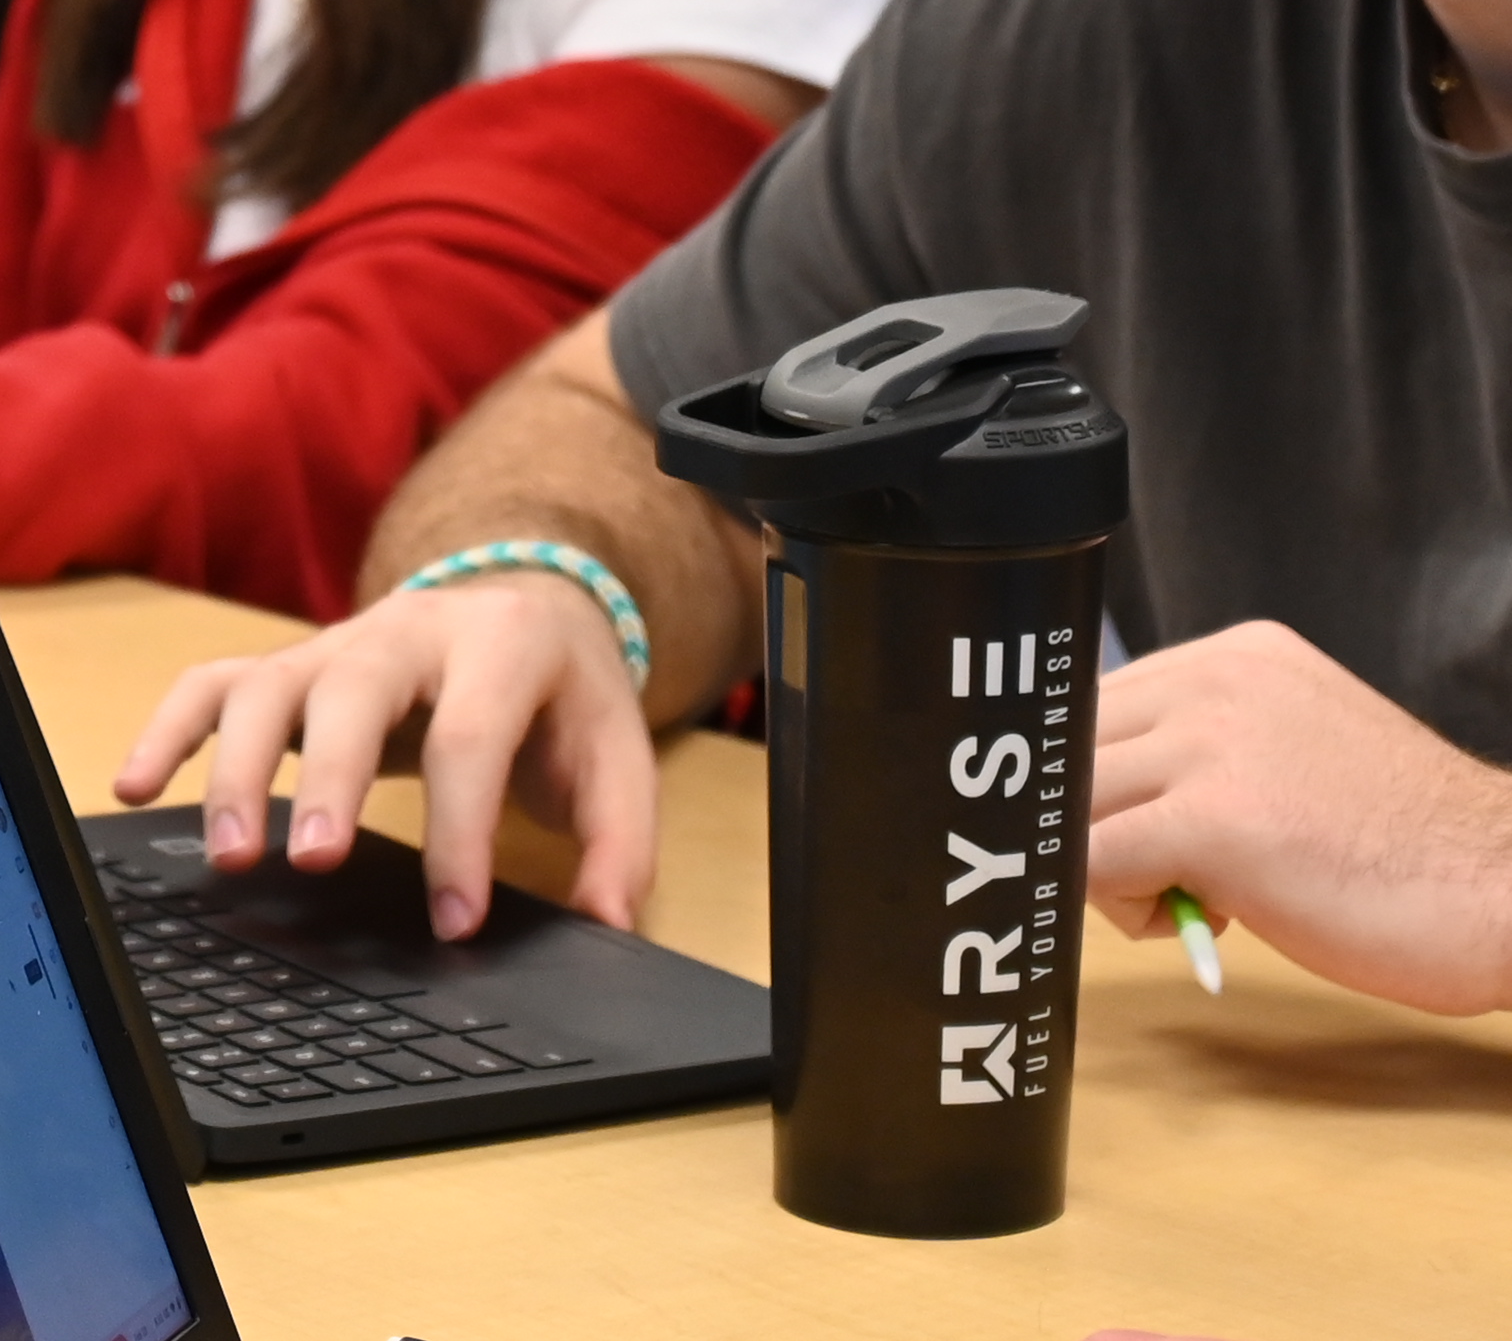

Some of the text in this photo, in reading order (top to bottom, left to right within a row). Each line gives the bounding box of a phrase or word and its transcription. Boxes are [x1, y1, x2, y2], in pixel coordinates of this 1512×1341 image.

[942, 633, 1037, 996] RYSE
[1024, 626, 1074, 1098] FUEL YOUR GREATNESS
